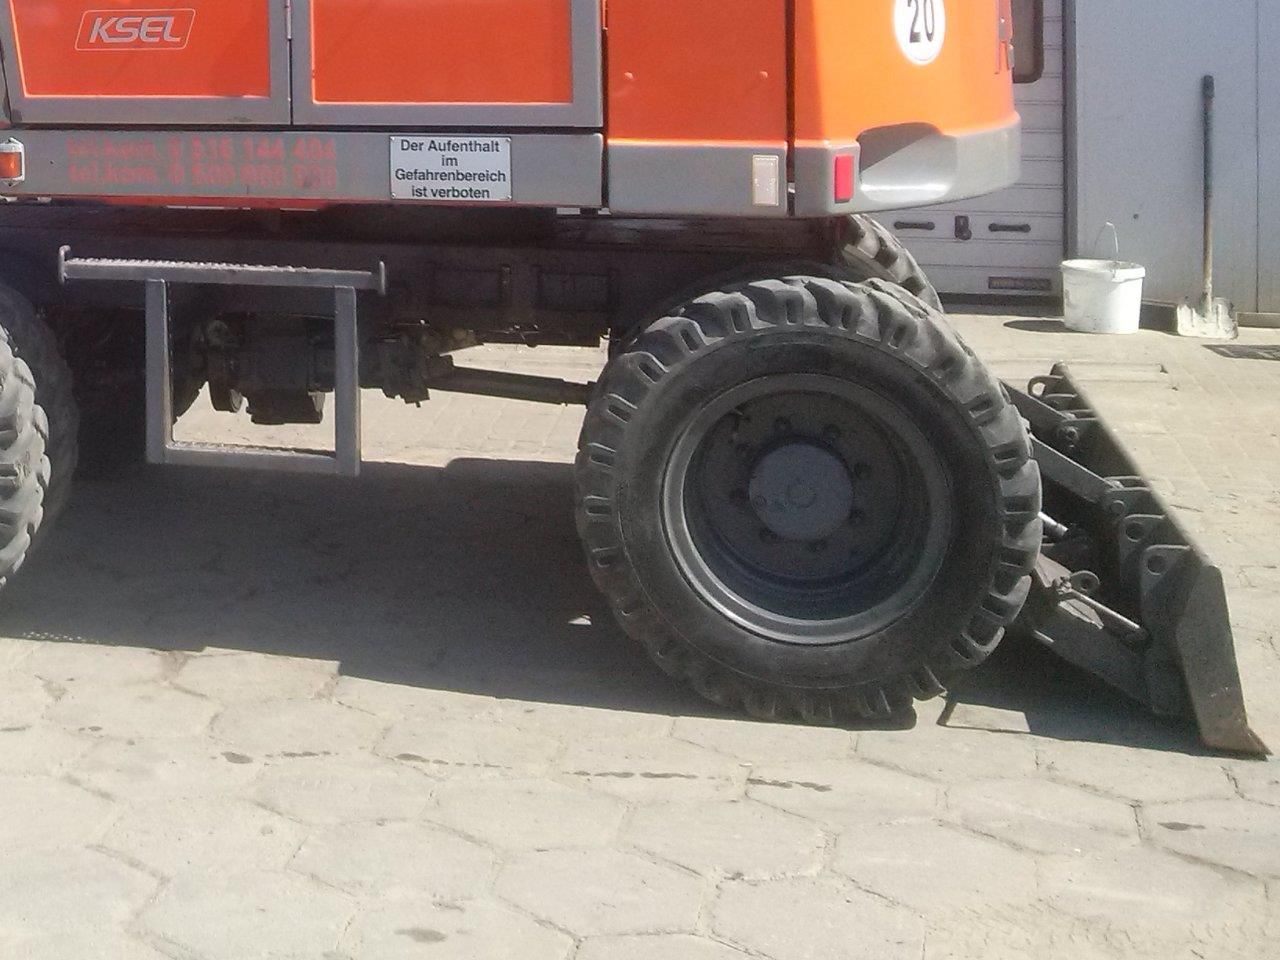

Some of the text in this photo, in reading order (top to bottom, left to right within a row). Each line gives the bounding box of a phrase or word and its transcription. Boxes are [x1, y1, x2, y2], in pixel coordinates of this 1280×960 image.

[89, 16, 182, 43] KSEL
[400, 140, 500, 152] Der Aufenthalt
[441, 155, 458, 166] im
[395, 168, 506, 182] Gefahrenbereich
[412, 185, 490, 198] ist verboten
